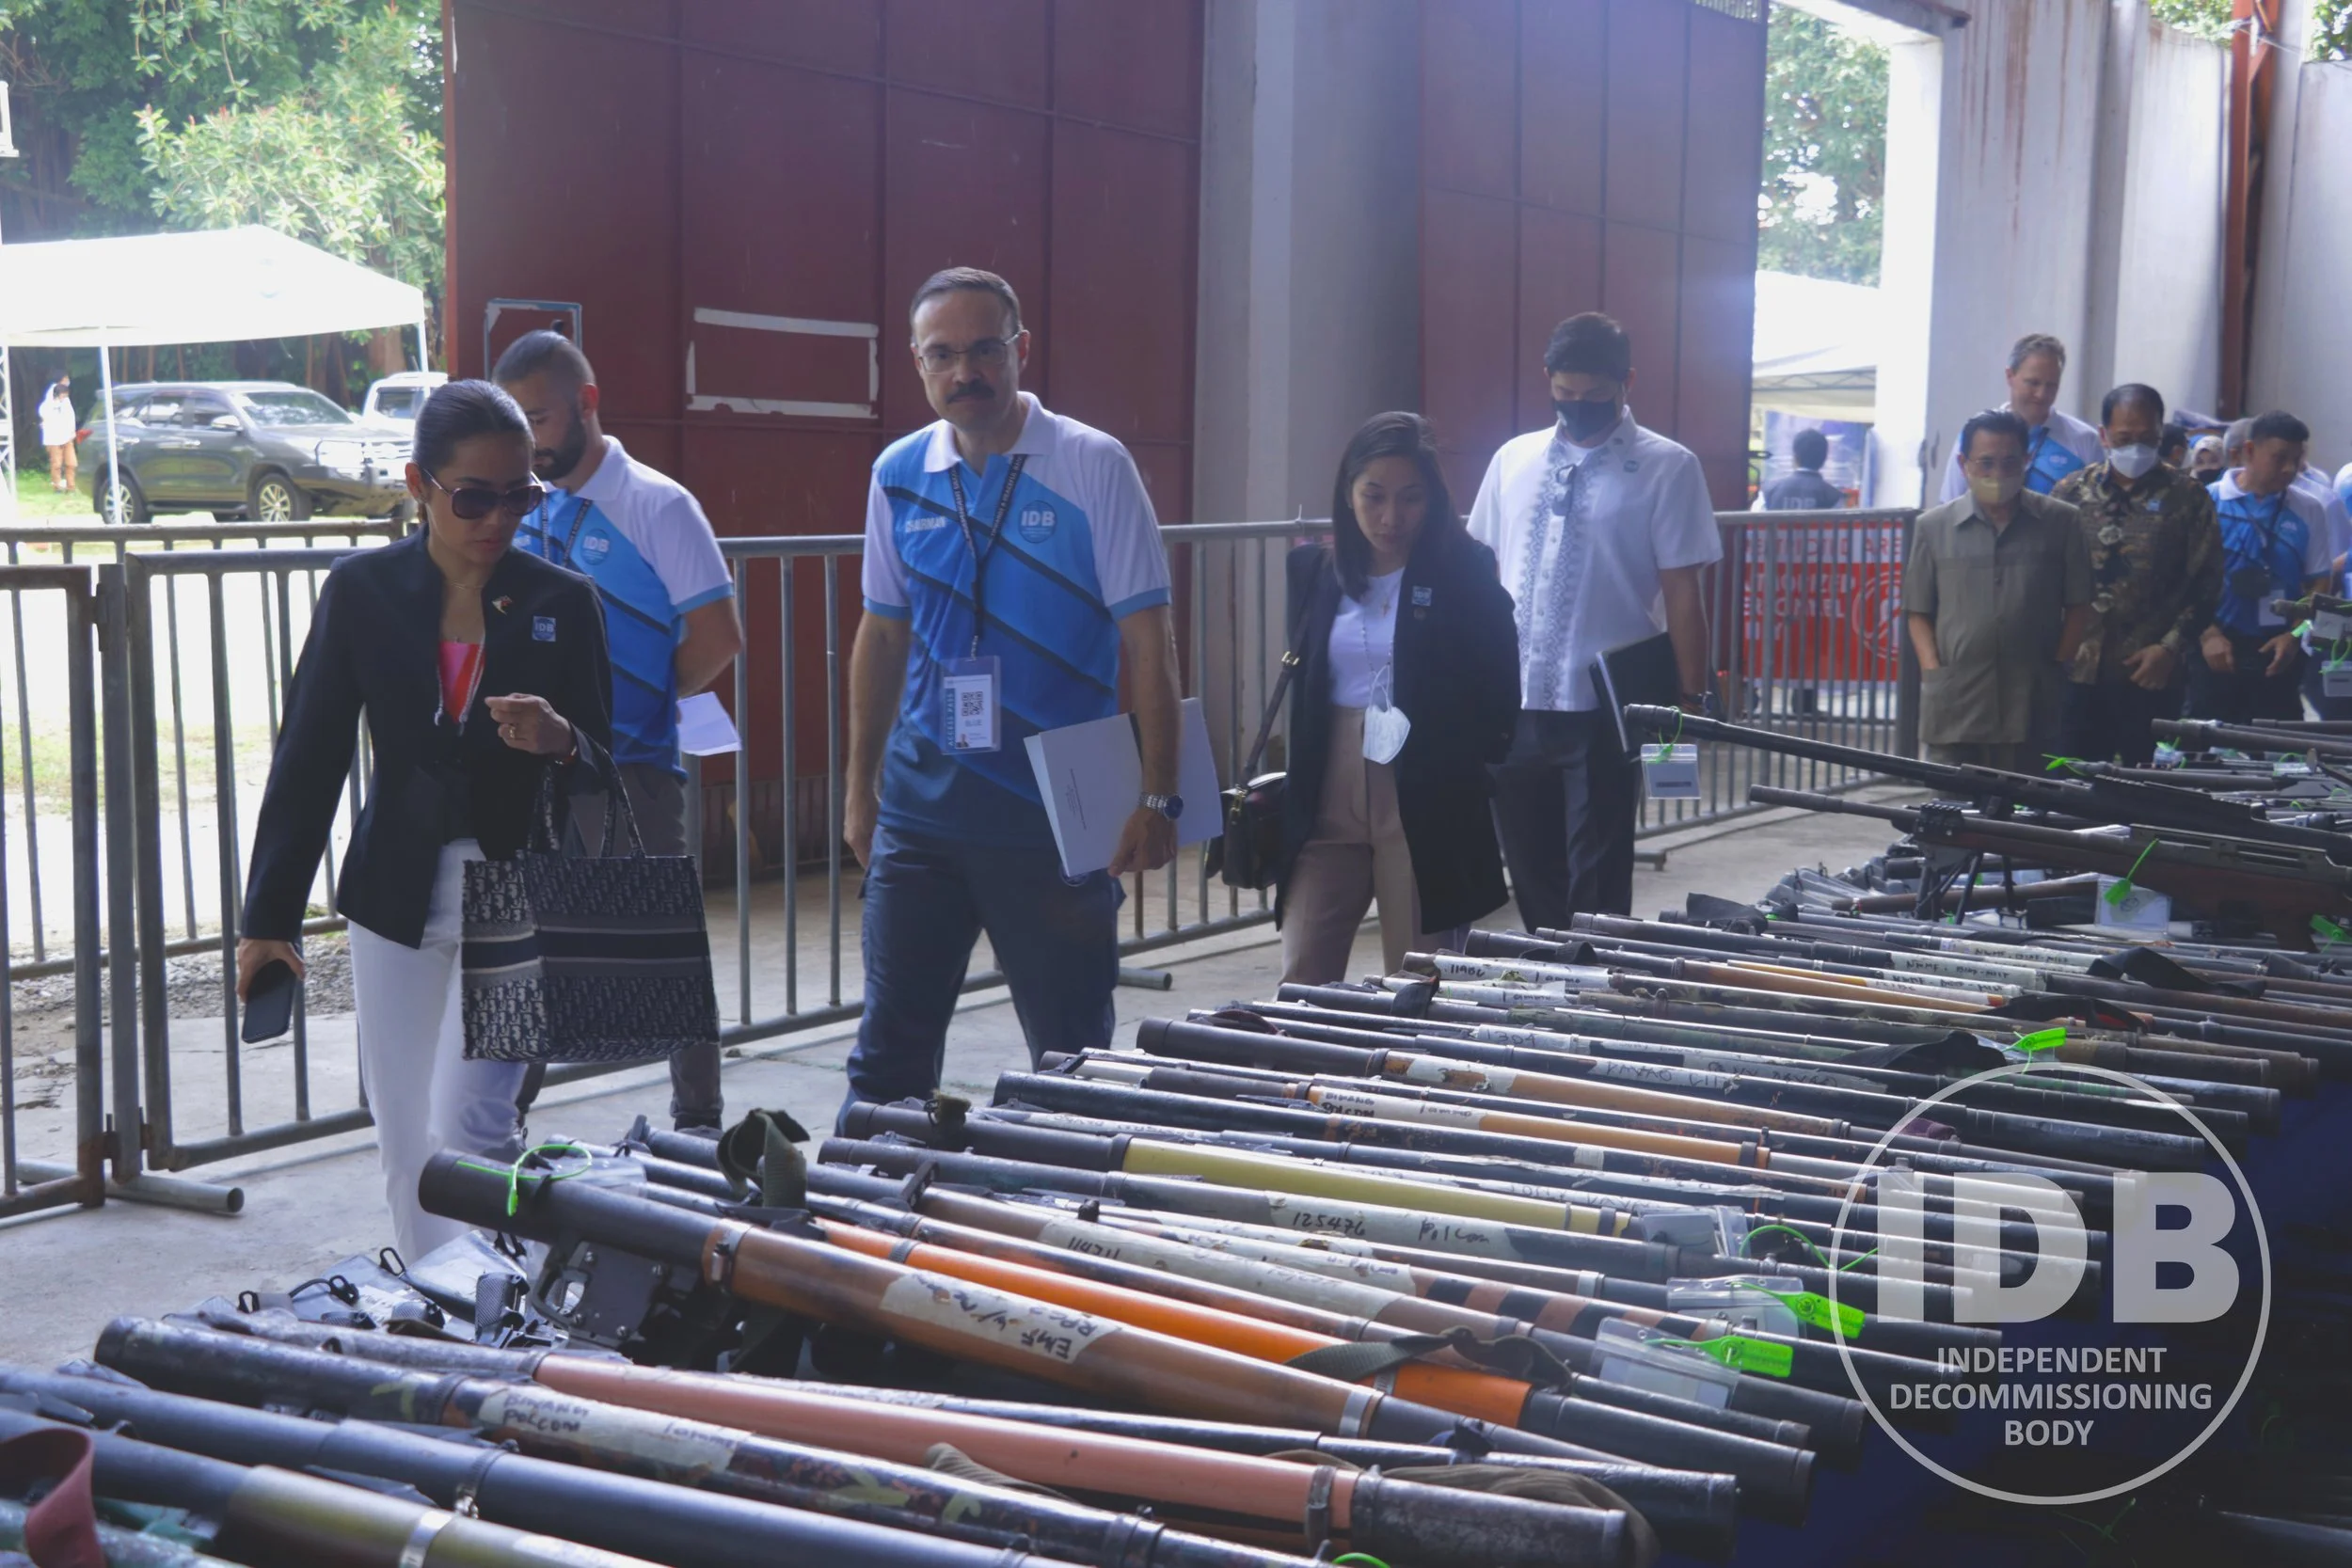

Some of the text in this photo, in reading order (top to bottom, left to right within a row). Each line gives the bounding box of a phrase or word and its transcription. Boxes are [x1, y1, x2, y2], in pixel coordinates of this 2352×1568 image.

[1021, 510, 1056, 527] IDB
[582, 535, 610, 553] IDB
[534, 622, 555, 633] IDB
[1293, 1212, 1366, 1236] 125476
